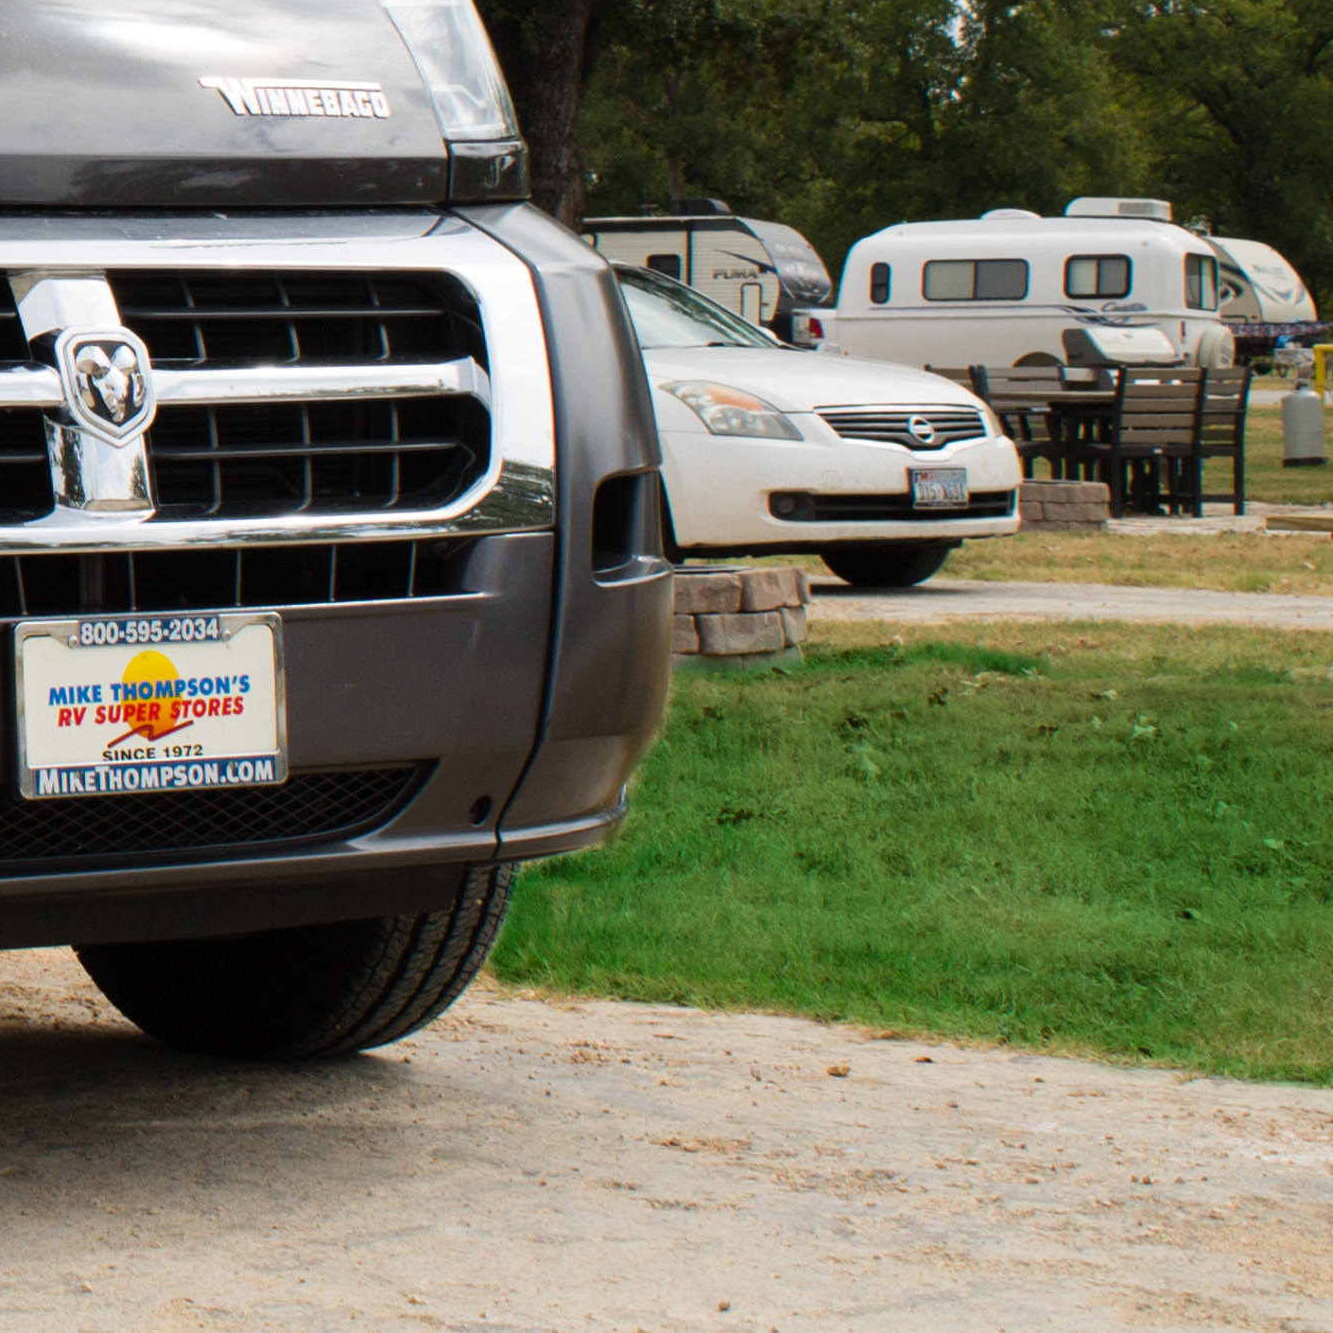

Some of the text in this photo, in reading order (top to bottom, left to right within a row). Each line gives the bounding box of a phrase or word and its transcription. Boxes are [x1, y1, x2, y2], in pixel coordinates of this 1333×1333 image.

[198, 76, 391, 119] WINNEBAGO
[48, 675, 250, 706] MIKE THOMPSON'S
[58, 695, 245, 727] RV SUPER STORES
[102, 743, 204, 762] SINCE 1972
